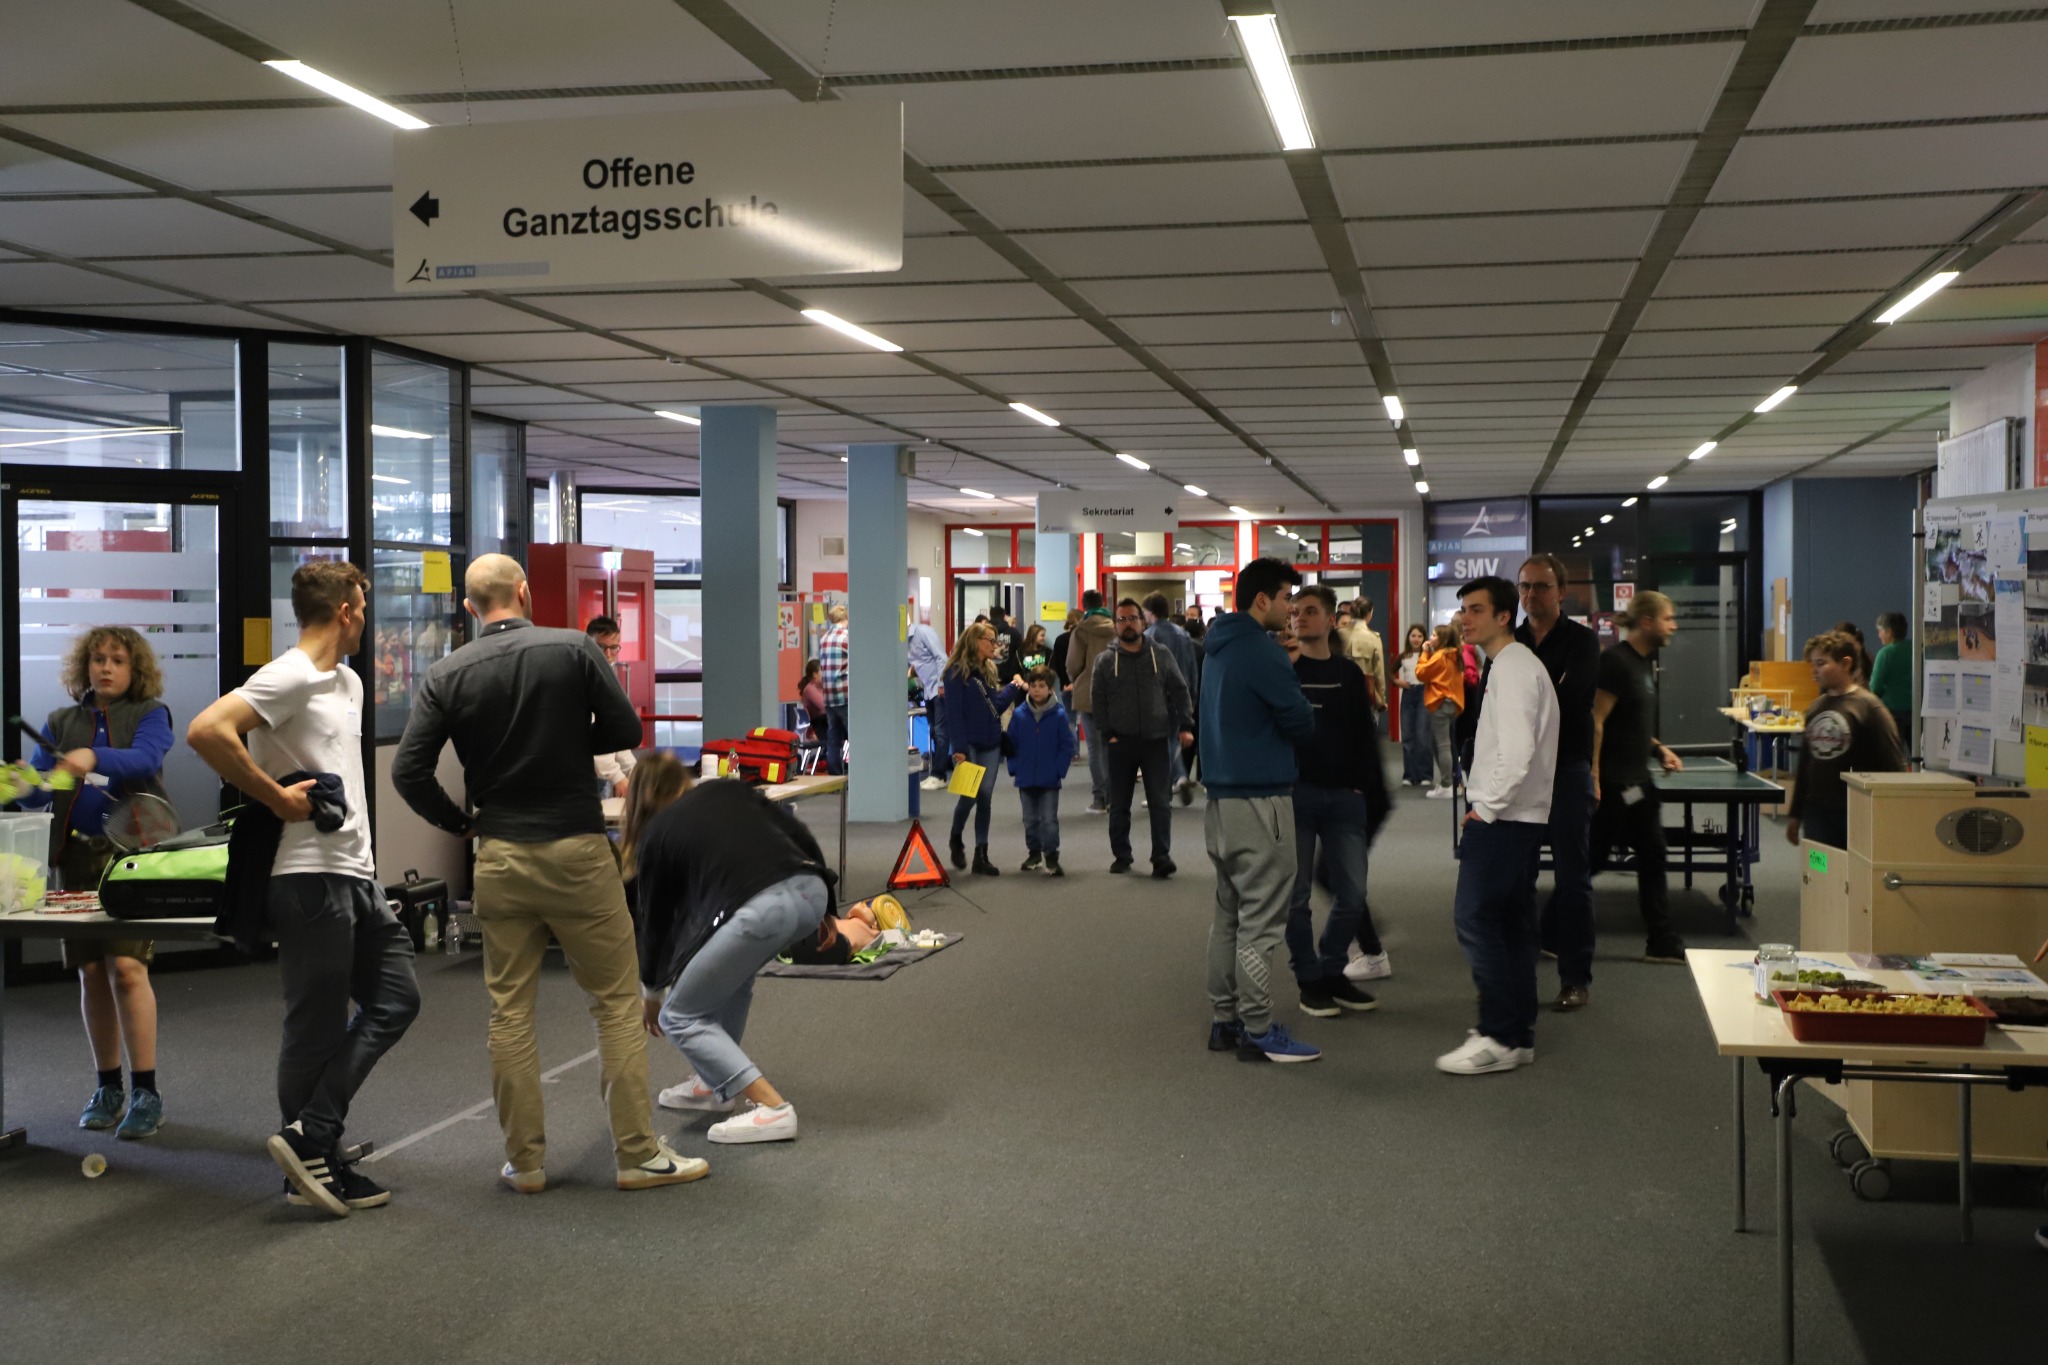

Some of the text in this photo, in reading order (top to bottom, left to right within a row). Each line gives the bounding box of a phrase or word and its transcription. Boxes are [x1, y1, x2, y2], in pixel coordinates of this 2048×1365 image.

[583, 157, 695, 189] Offene
[438, 265, 474, 277] APIAN
[1082, 506, 1135, 516] Sekretariat
[1430, 542, 1460, 551] APIAN
[1454, 558, 1499, 579] SMV
